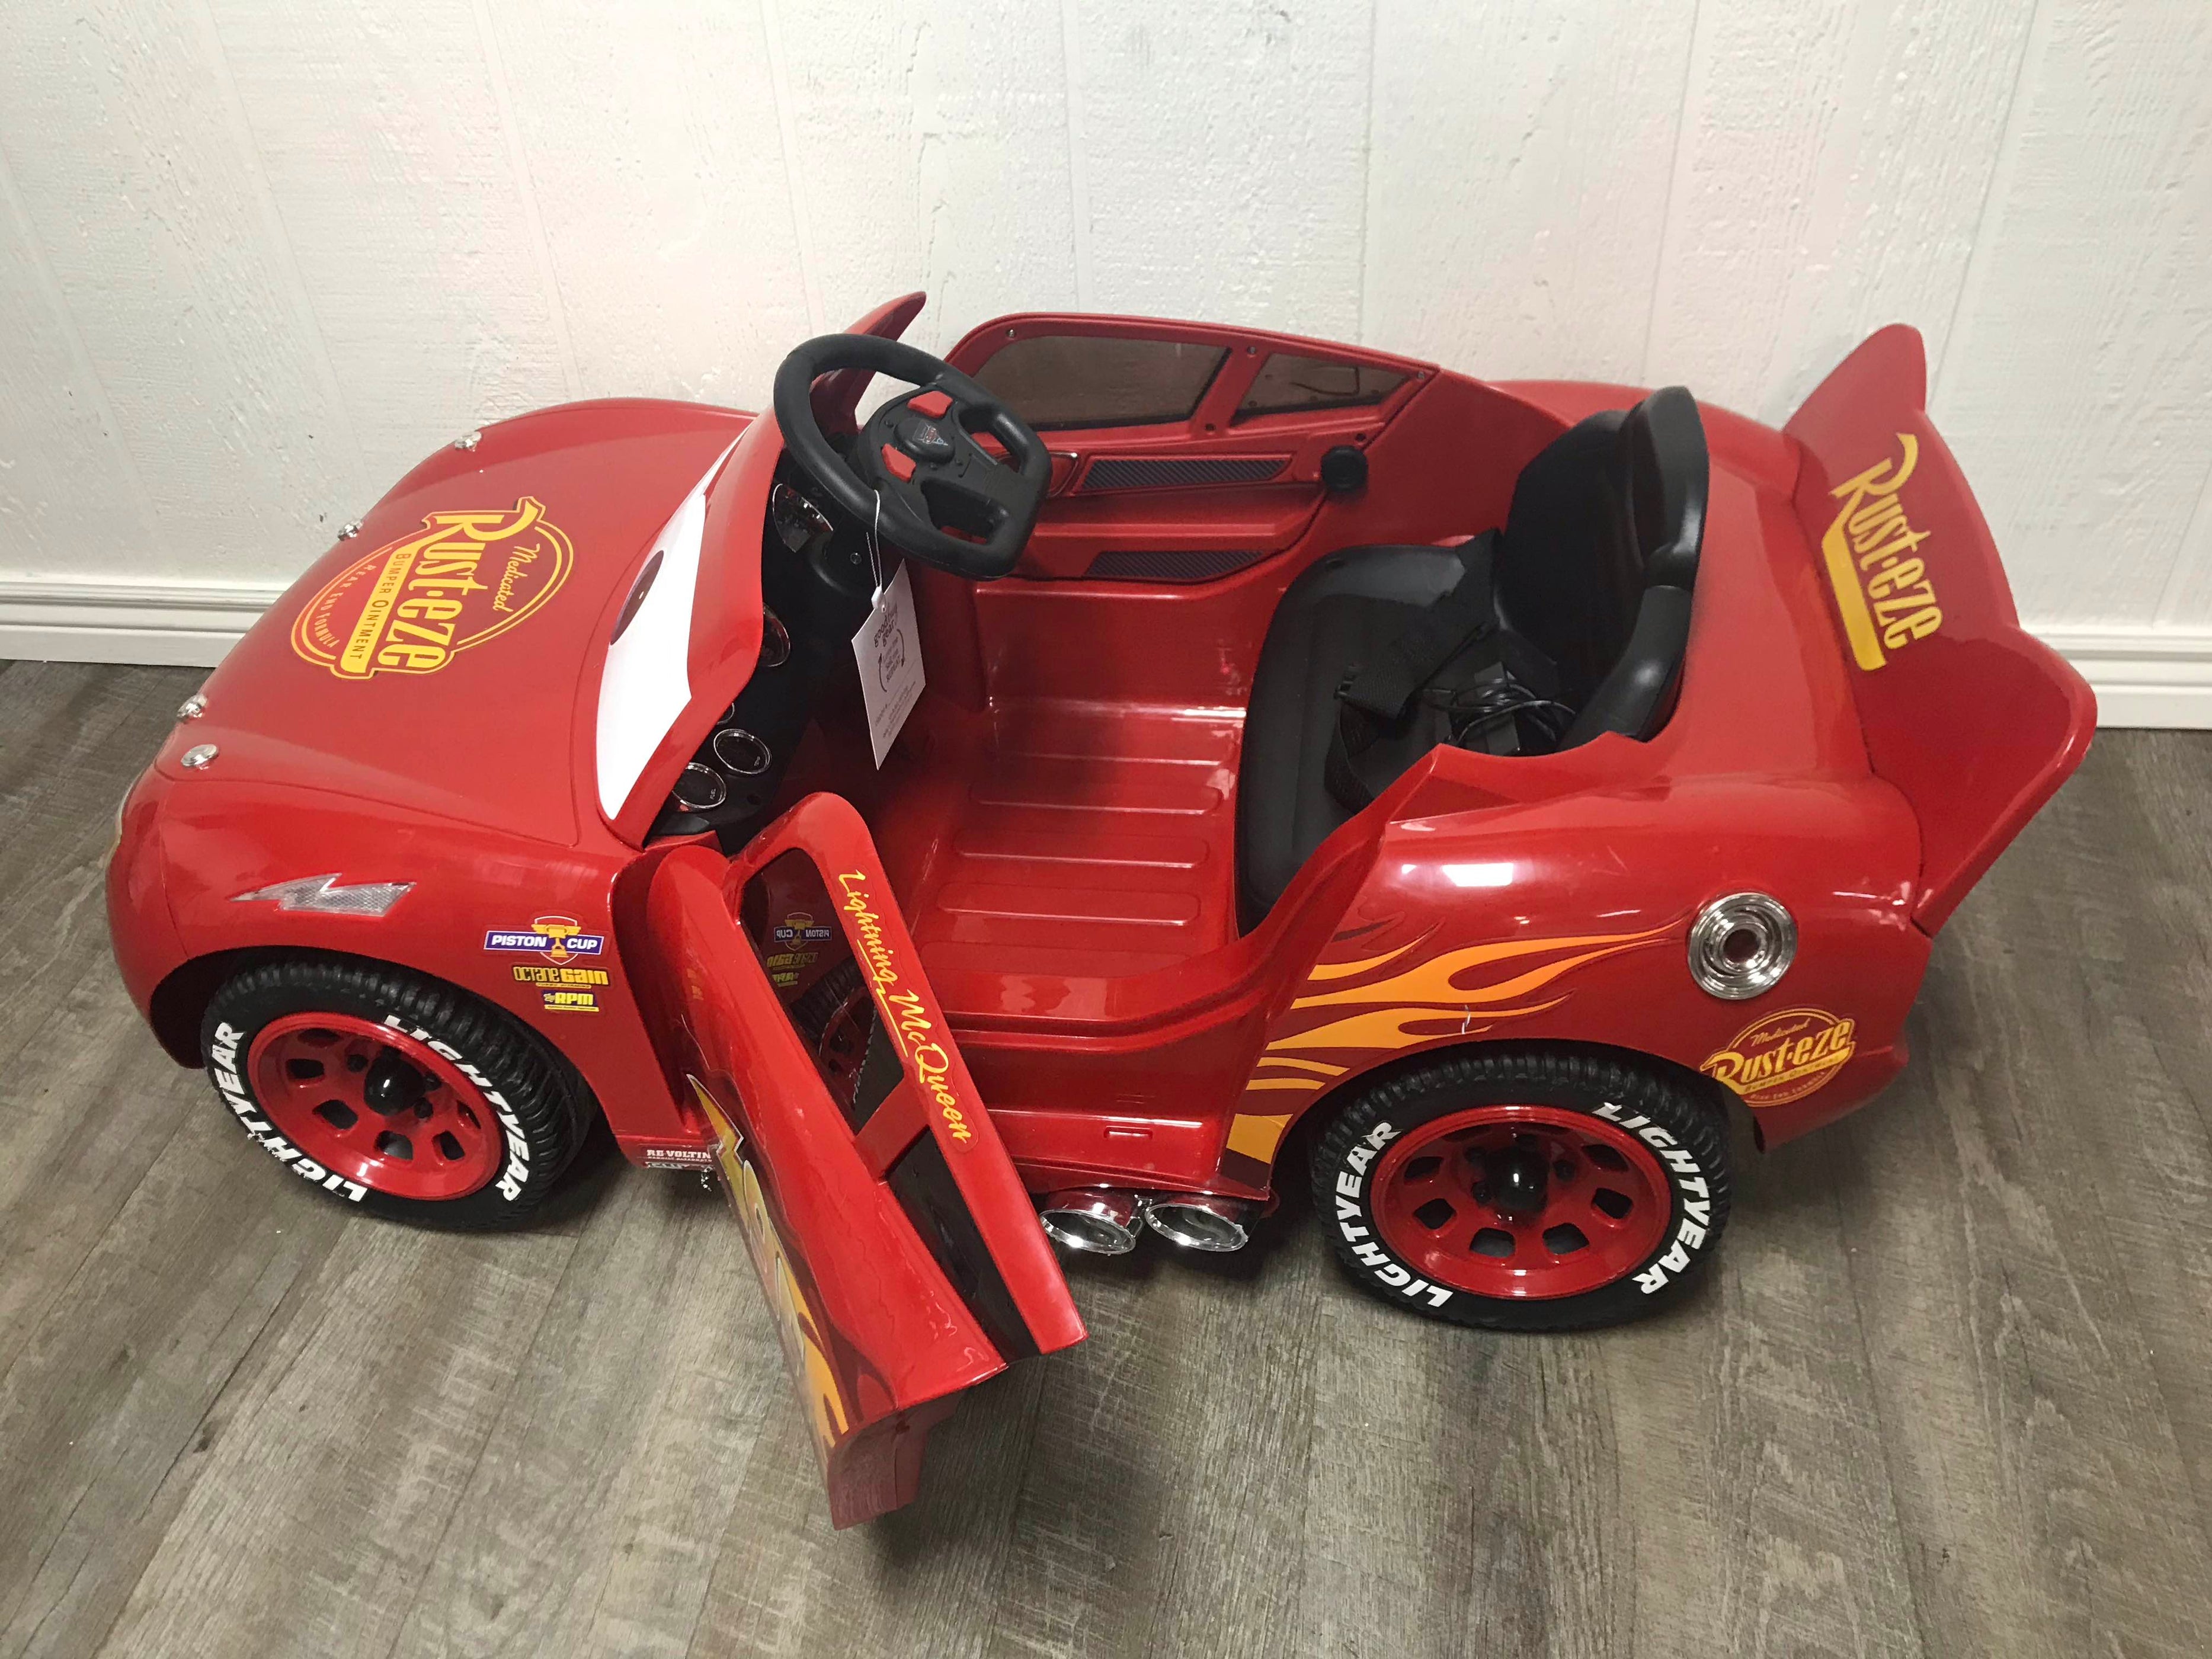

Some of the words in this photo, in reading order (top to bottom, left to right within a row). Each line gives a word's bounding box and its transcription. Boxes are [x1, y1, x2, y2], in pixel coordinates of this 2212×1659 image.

[324, 591, 344, 614] END
[340, 564, 376, 591] REAR
[380, 553, 412, 594] BUMPER
[492, 543, 541, 613] Medicated
[313, 611, 340, 648] FORMULA
[349, 598, 383, 660] OINTMENT
[491, 935, 547, 947] PISTON
[566, 938, 598, 950] CUP
[555, 992, 594, 1005] RPM
[838, 869, 898, 986] Lightning
[889, 989, 972, 1144] McQueen
[211, 1021, 368, 1203] LIGHTYEAR
[384, 1014, 530, 1202] LIGHTYEAR
[1335, 1121, 1454, 1308] LIGHTYEAR
[1592, 1101, 1713, 1295] LIGHTYEAR
